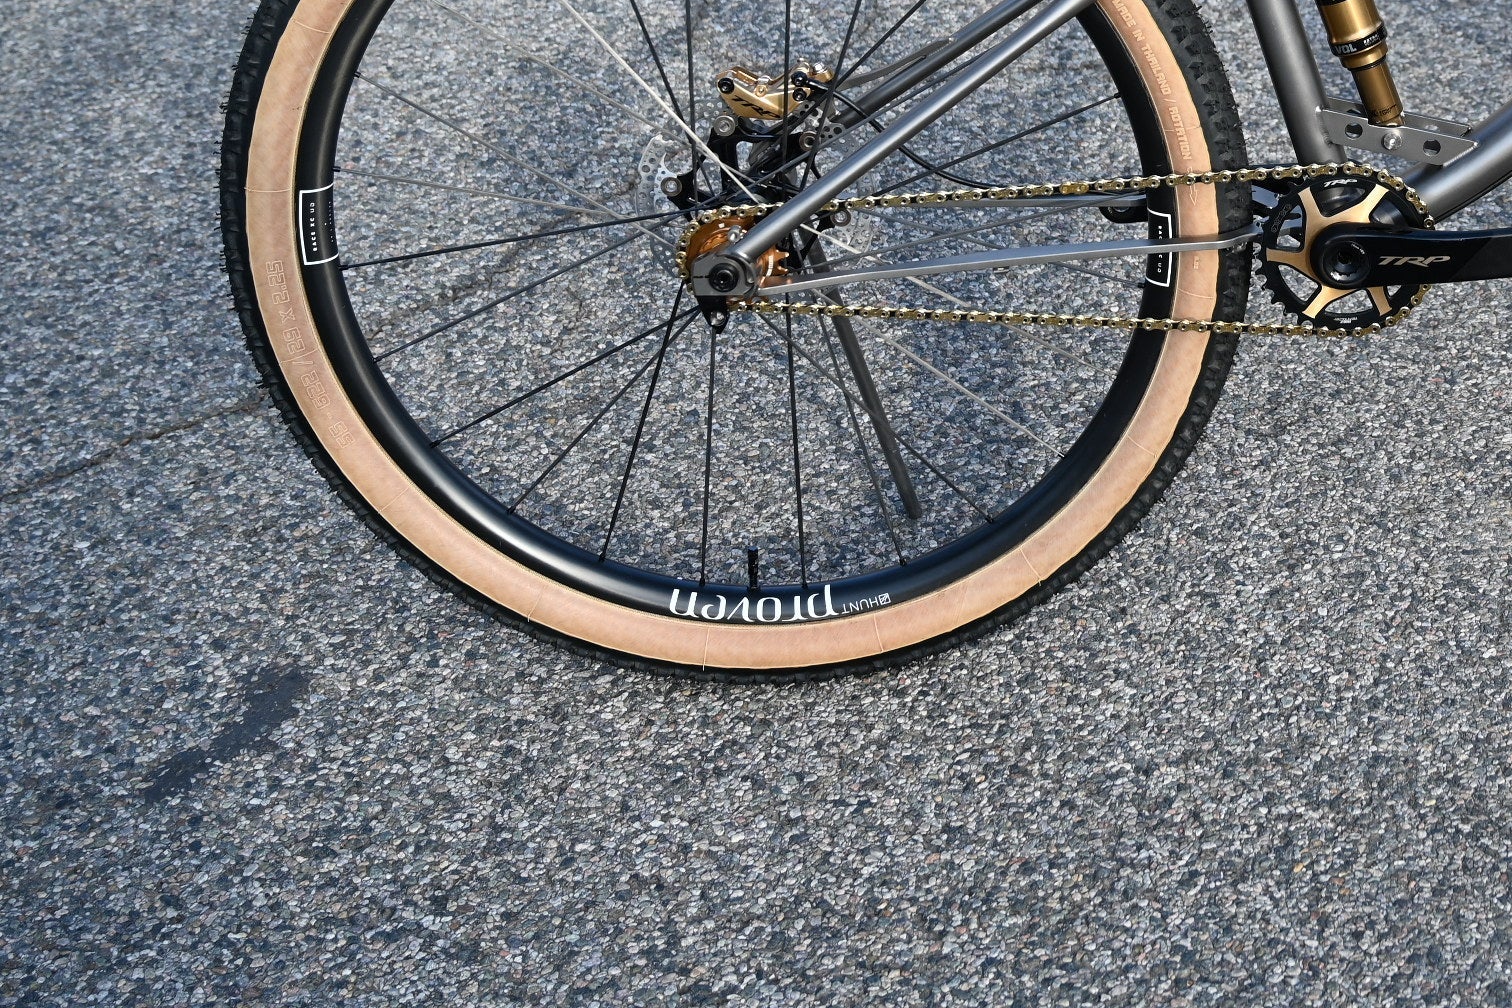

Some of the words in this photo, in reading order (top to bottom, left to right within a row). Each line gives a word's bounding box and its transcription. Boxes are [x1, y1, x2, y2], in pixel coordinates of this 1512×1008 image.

[1132, 28, 1146, 42] IN
[1141, 43, 1172, 96] THAILAND
[1168, 106, 1193, 161] ROTATION
[731, 95, 781, 118] TRP
[1323, 178, 1358, 189] TRP
[1377, 255, 1451, 268] TRP
[265, 260, 290, 305] 2.25
[669, 584, 843, 623] proven
[843, 596, 878, 614] HUNT
